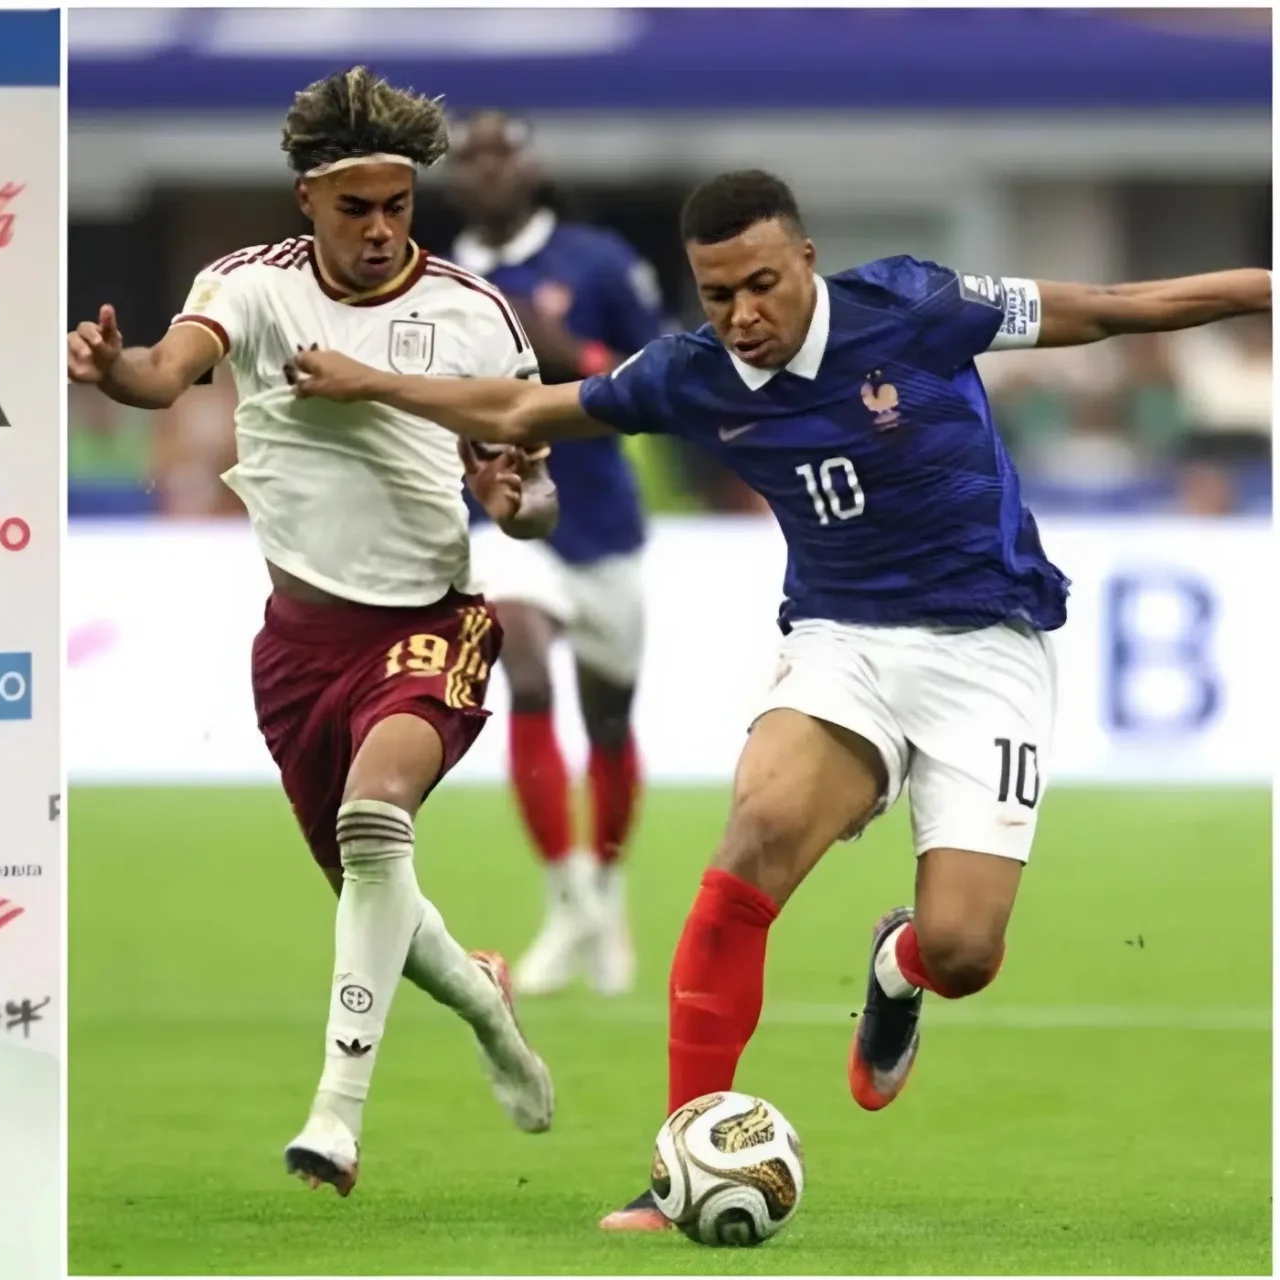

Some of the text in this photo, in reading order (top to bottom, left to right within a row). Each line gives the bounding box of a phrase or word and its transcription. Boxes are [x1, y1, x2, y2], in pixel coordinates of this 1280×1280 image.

[795, 457, 864, 525] 10
[385, 634, 449, 678] 19
[1108, 568, 1223, 738] B
[995, 738, 1039, 809] 10
